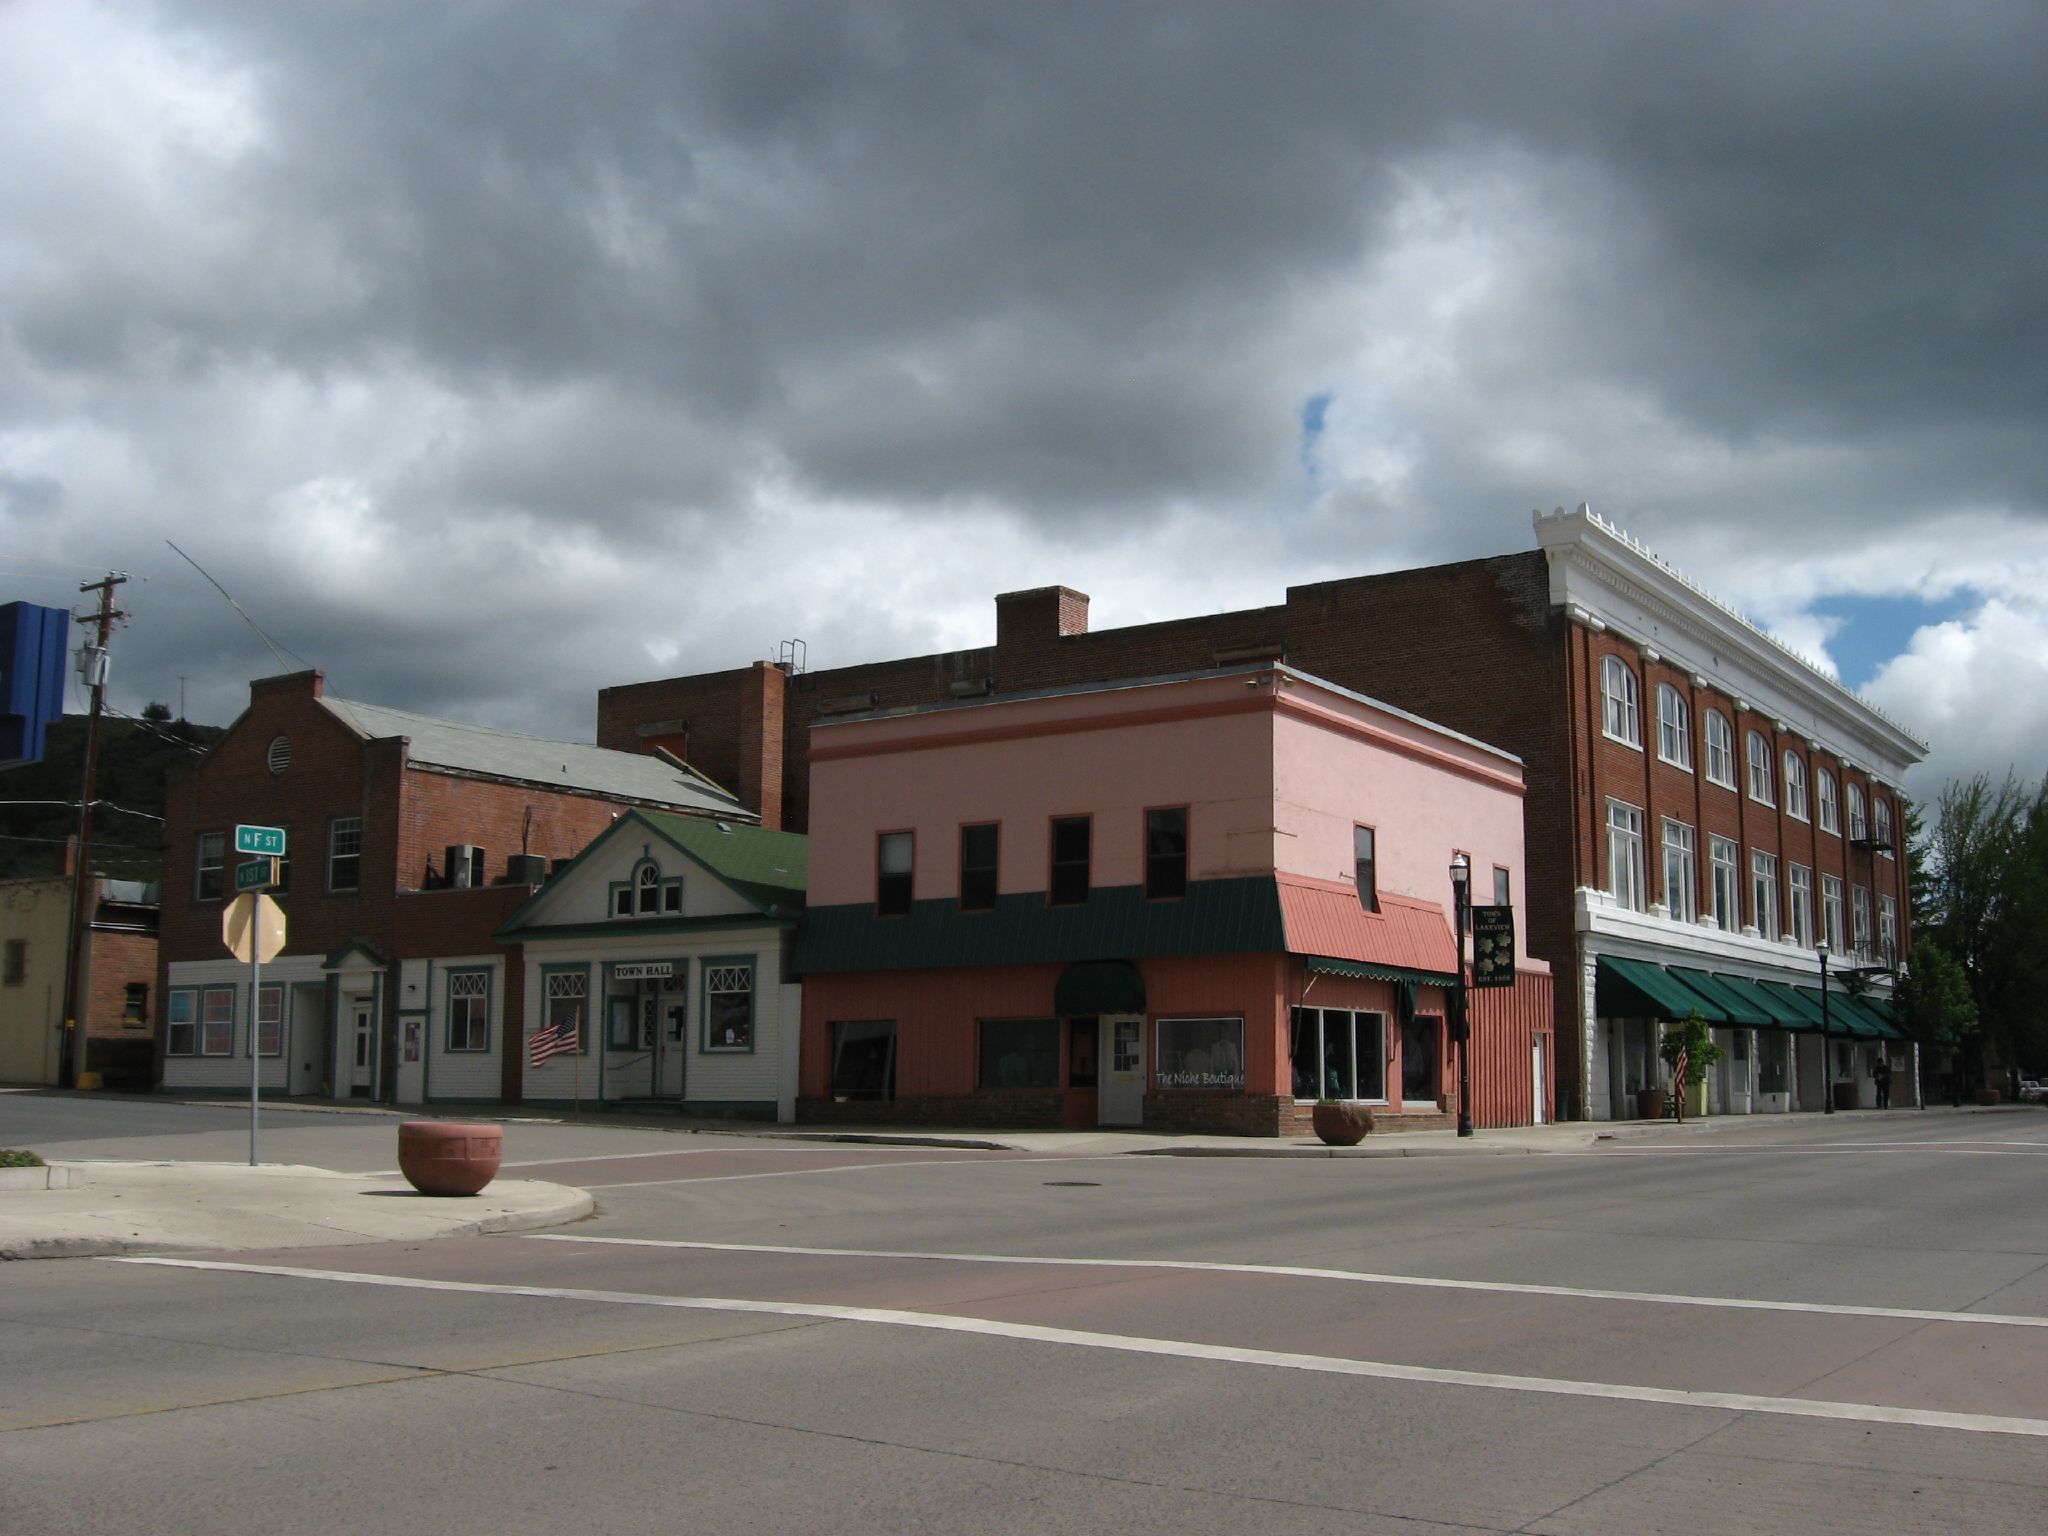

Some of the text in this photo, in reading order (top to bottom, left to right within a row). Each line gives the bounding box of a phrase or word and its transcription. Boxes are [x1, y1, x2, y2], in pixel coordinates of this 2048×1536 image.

[244, 832, 278, 848] N F ST
[1475, 923, 1510, 931] LAKEVIEW
[615, 965, 672, 977] TOWN HALL
[1155, 1069, 1245, 1089] The Niche Boutique
